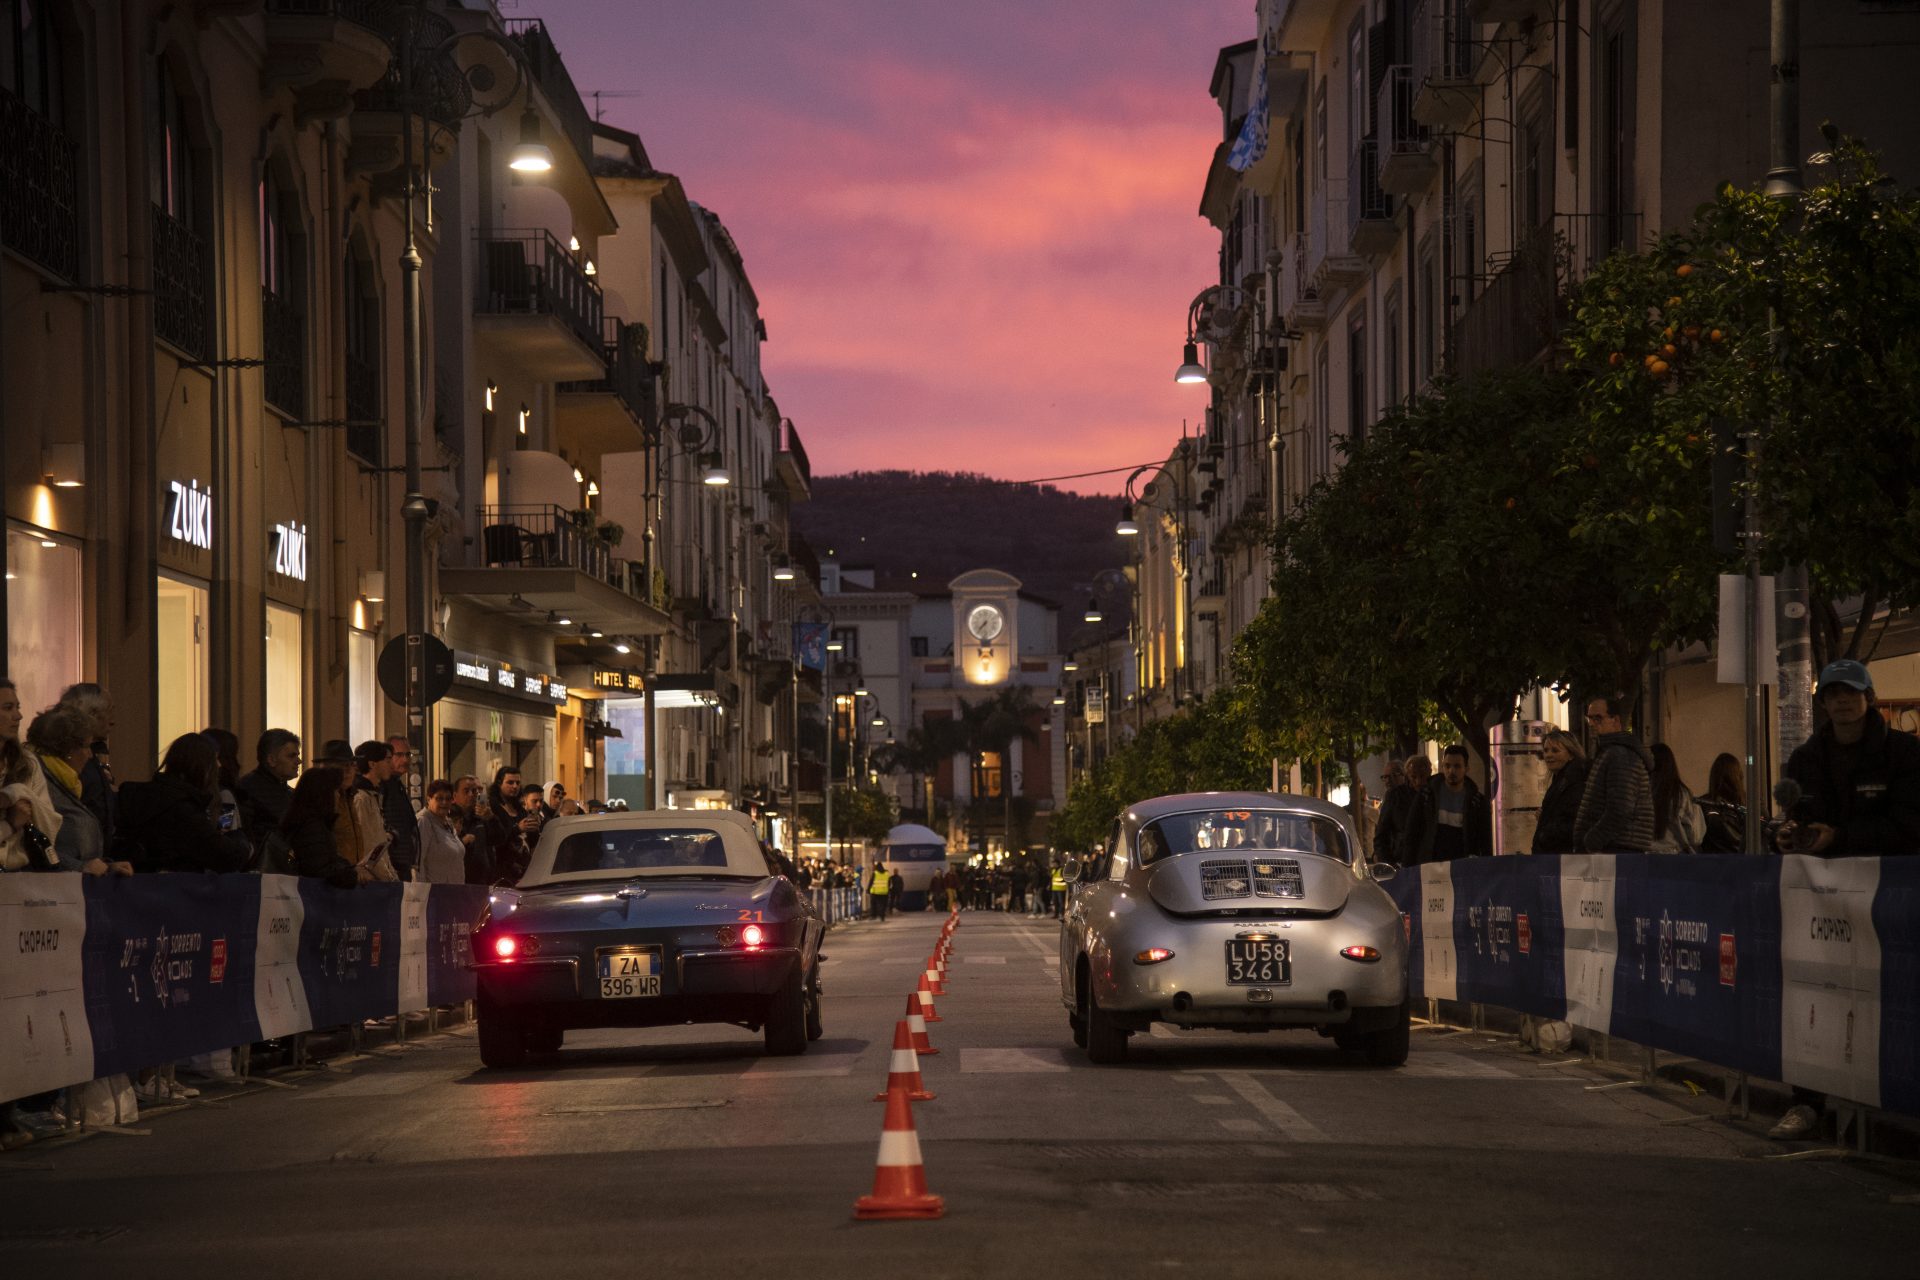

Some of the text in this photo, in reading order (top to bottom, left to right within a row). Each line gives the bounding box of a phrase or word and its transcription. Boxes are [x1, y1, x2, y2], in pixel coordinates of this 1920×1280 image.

[1223, 811, 1251, 821] 19
[737, 909, 762, 922] 21
[1580, 900, 1604, 919] CHOPARD
[1675, 920, 1708, 943] SORRENTO
[1811, 916, 1852, 943] CHOPARD
[19, 929, 59, 953] CHOPARD
[171, 933, 202, 954] SORRENTO
[620, 957, 640, 975] ZA
[1232, 962, 1283, 980] 3461
[602, 977, 659, 996] 396 WR
